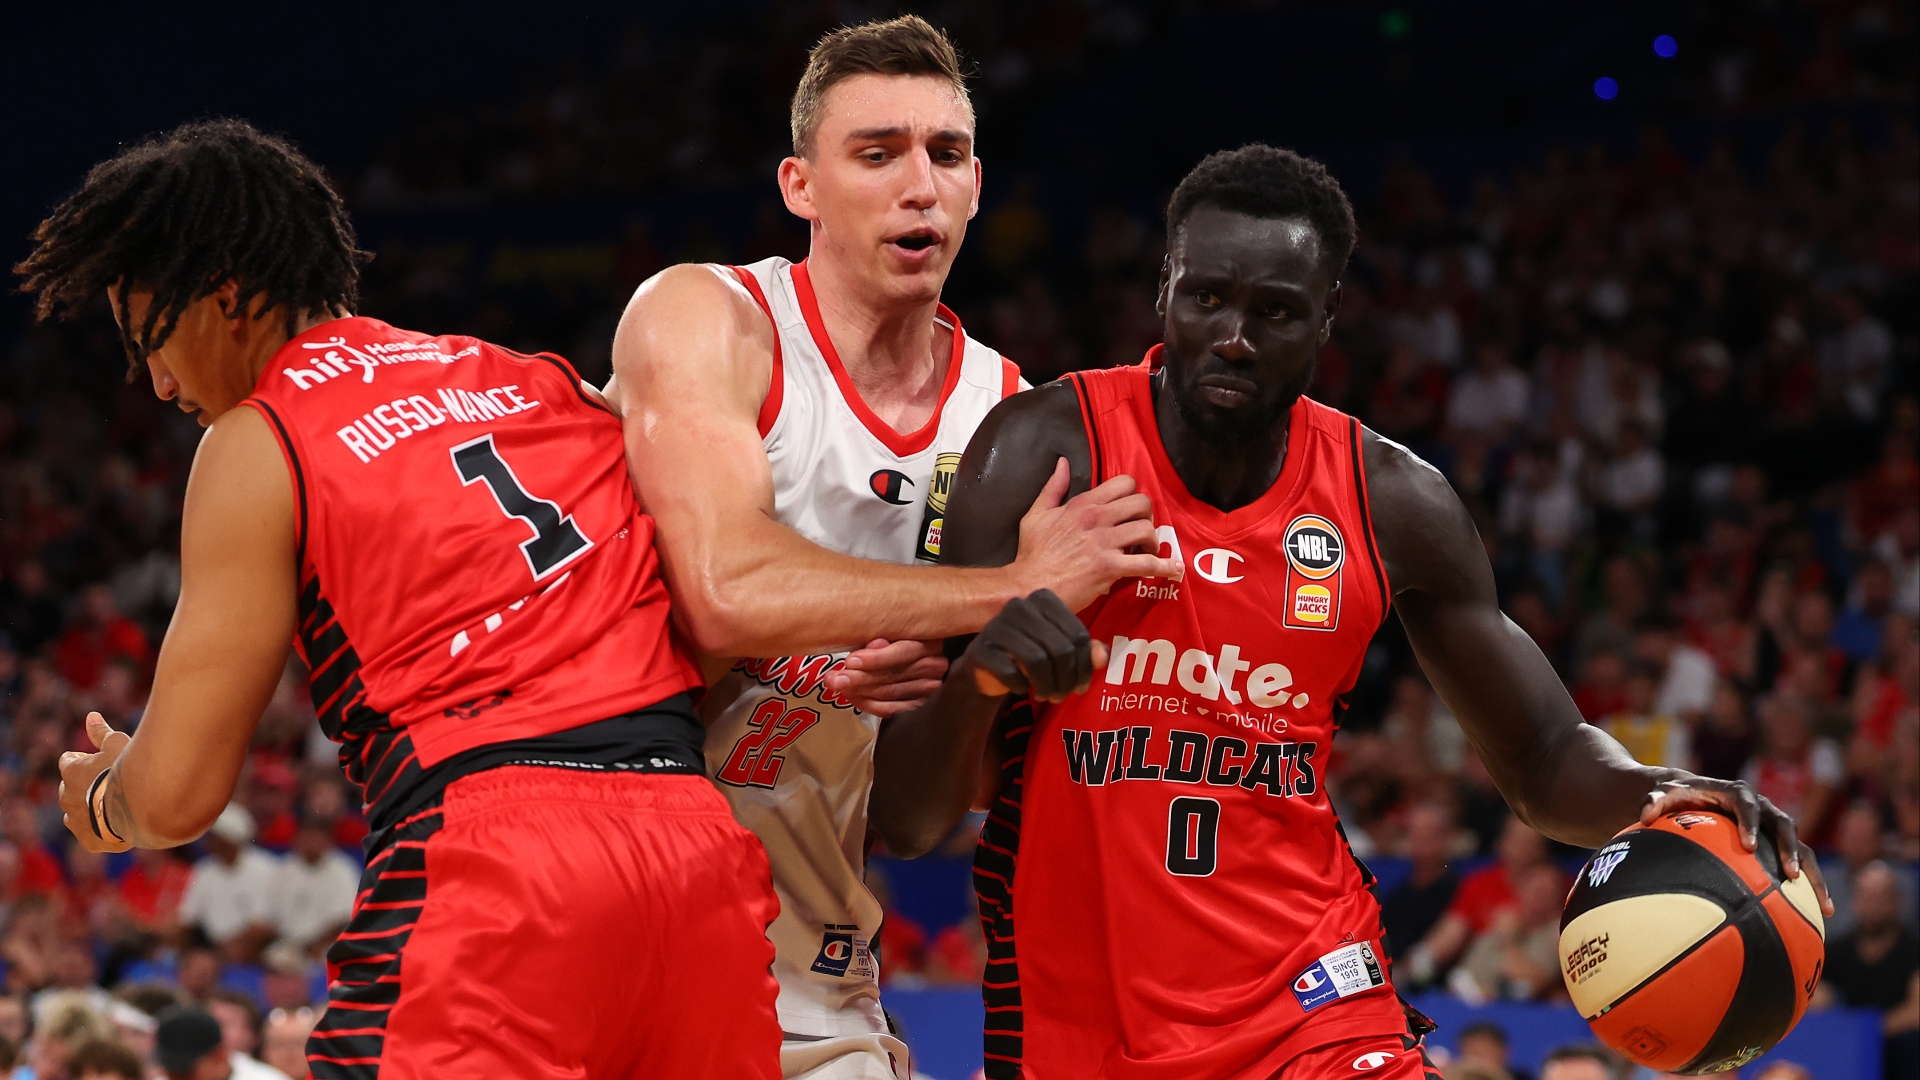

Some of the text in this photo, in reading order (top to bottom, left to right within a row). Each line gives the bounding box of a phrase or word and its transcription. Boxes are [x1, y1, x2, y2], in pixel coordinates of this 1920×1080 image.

[283, 350, 352, 390] hif
[336, 384, 541, 464] RUSSO-NANCE
[449, 433, 595, 582] 1
[1297, 533, 1331, 561] NBL
[1136, 580, 1180, 601] bank
[1297, 594, 1329, 604] HUNGRY
[1100, 689, 1189, 715] internet
[716, 696, 821, 790] 22
[1062, 726, 1318, 798] WILDCATS
[1165, 795, 1221, 877] 0
[1600, 841, 1631, 855] WNBL
[1332, 958, 1359, 974] SINCE
[1564, 932, 1609, 975] LEGACY
[1577, 952, 1607, 977] 1000
[1340, 968, 1359, 981] 1919
[1302, 988, 1336, 1006] Champion
